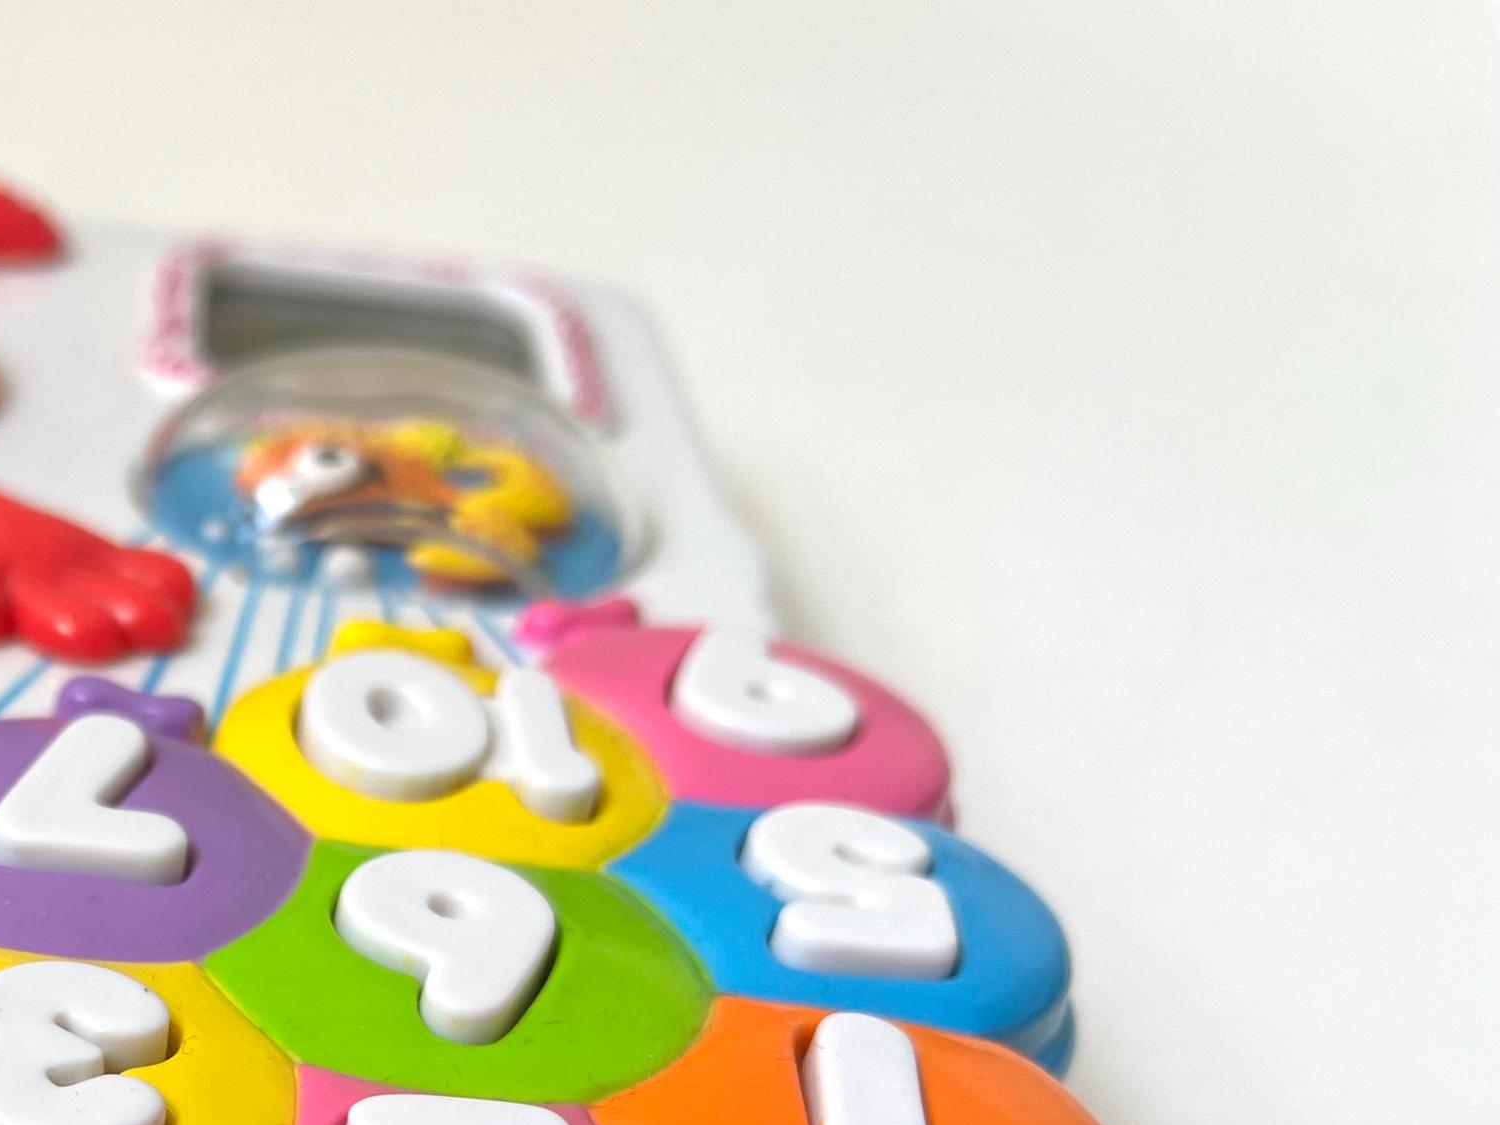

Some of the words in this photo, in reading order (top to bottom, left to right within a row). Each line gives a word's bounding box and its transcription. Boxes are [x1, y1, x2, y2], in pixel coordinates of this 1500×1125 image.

[297, 649, 600, 823] 10
[668, 622, 860, 756] 9
[334, 849, 558, 1045] 6
[737, 804, 958, 980] 5
